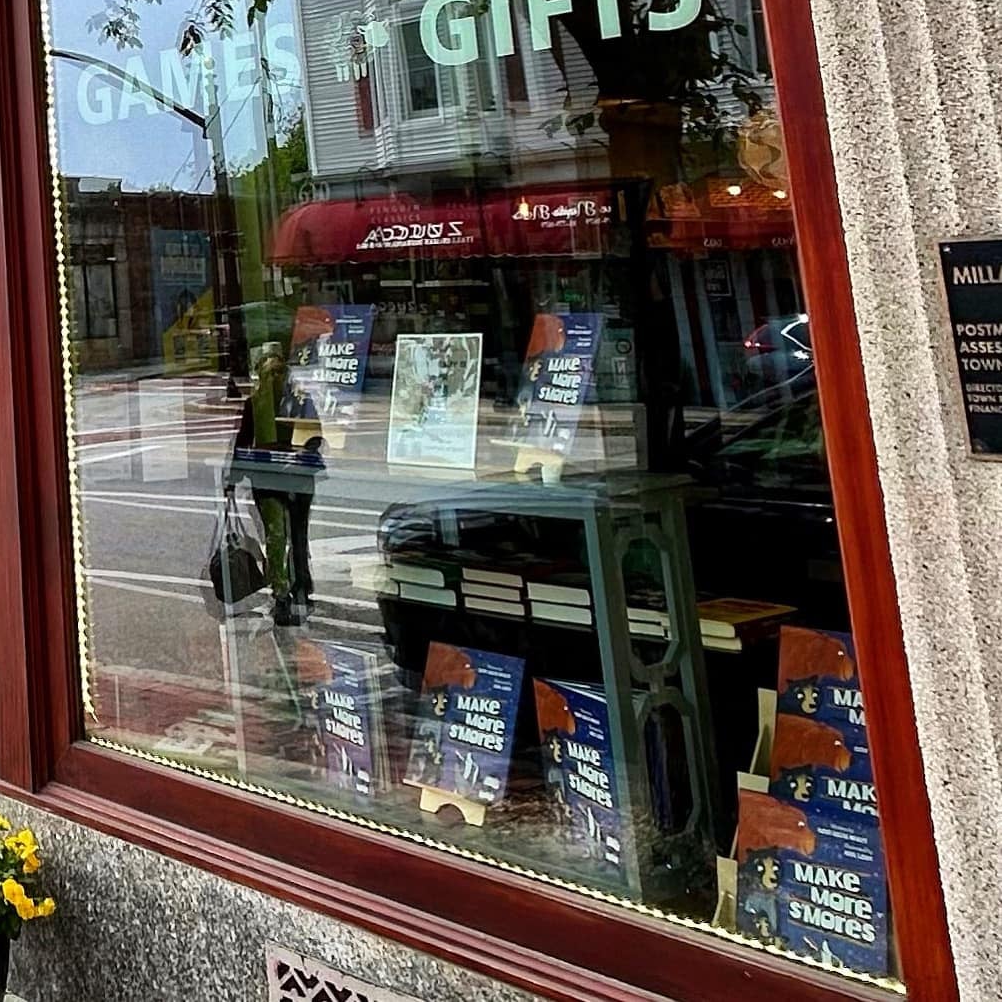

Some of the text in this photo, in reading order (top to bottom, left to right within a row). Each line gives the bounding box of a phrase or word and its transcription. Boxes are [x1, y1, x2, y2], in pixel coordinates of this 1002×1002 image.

[76, 22, 301, 126] GAMES
[953, 264, 1002, 285] MILL
[959, 341, 1002, 353] ASSES
[833, 689, 864, 708] MA
[827, 779, 877, 803] MAK
